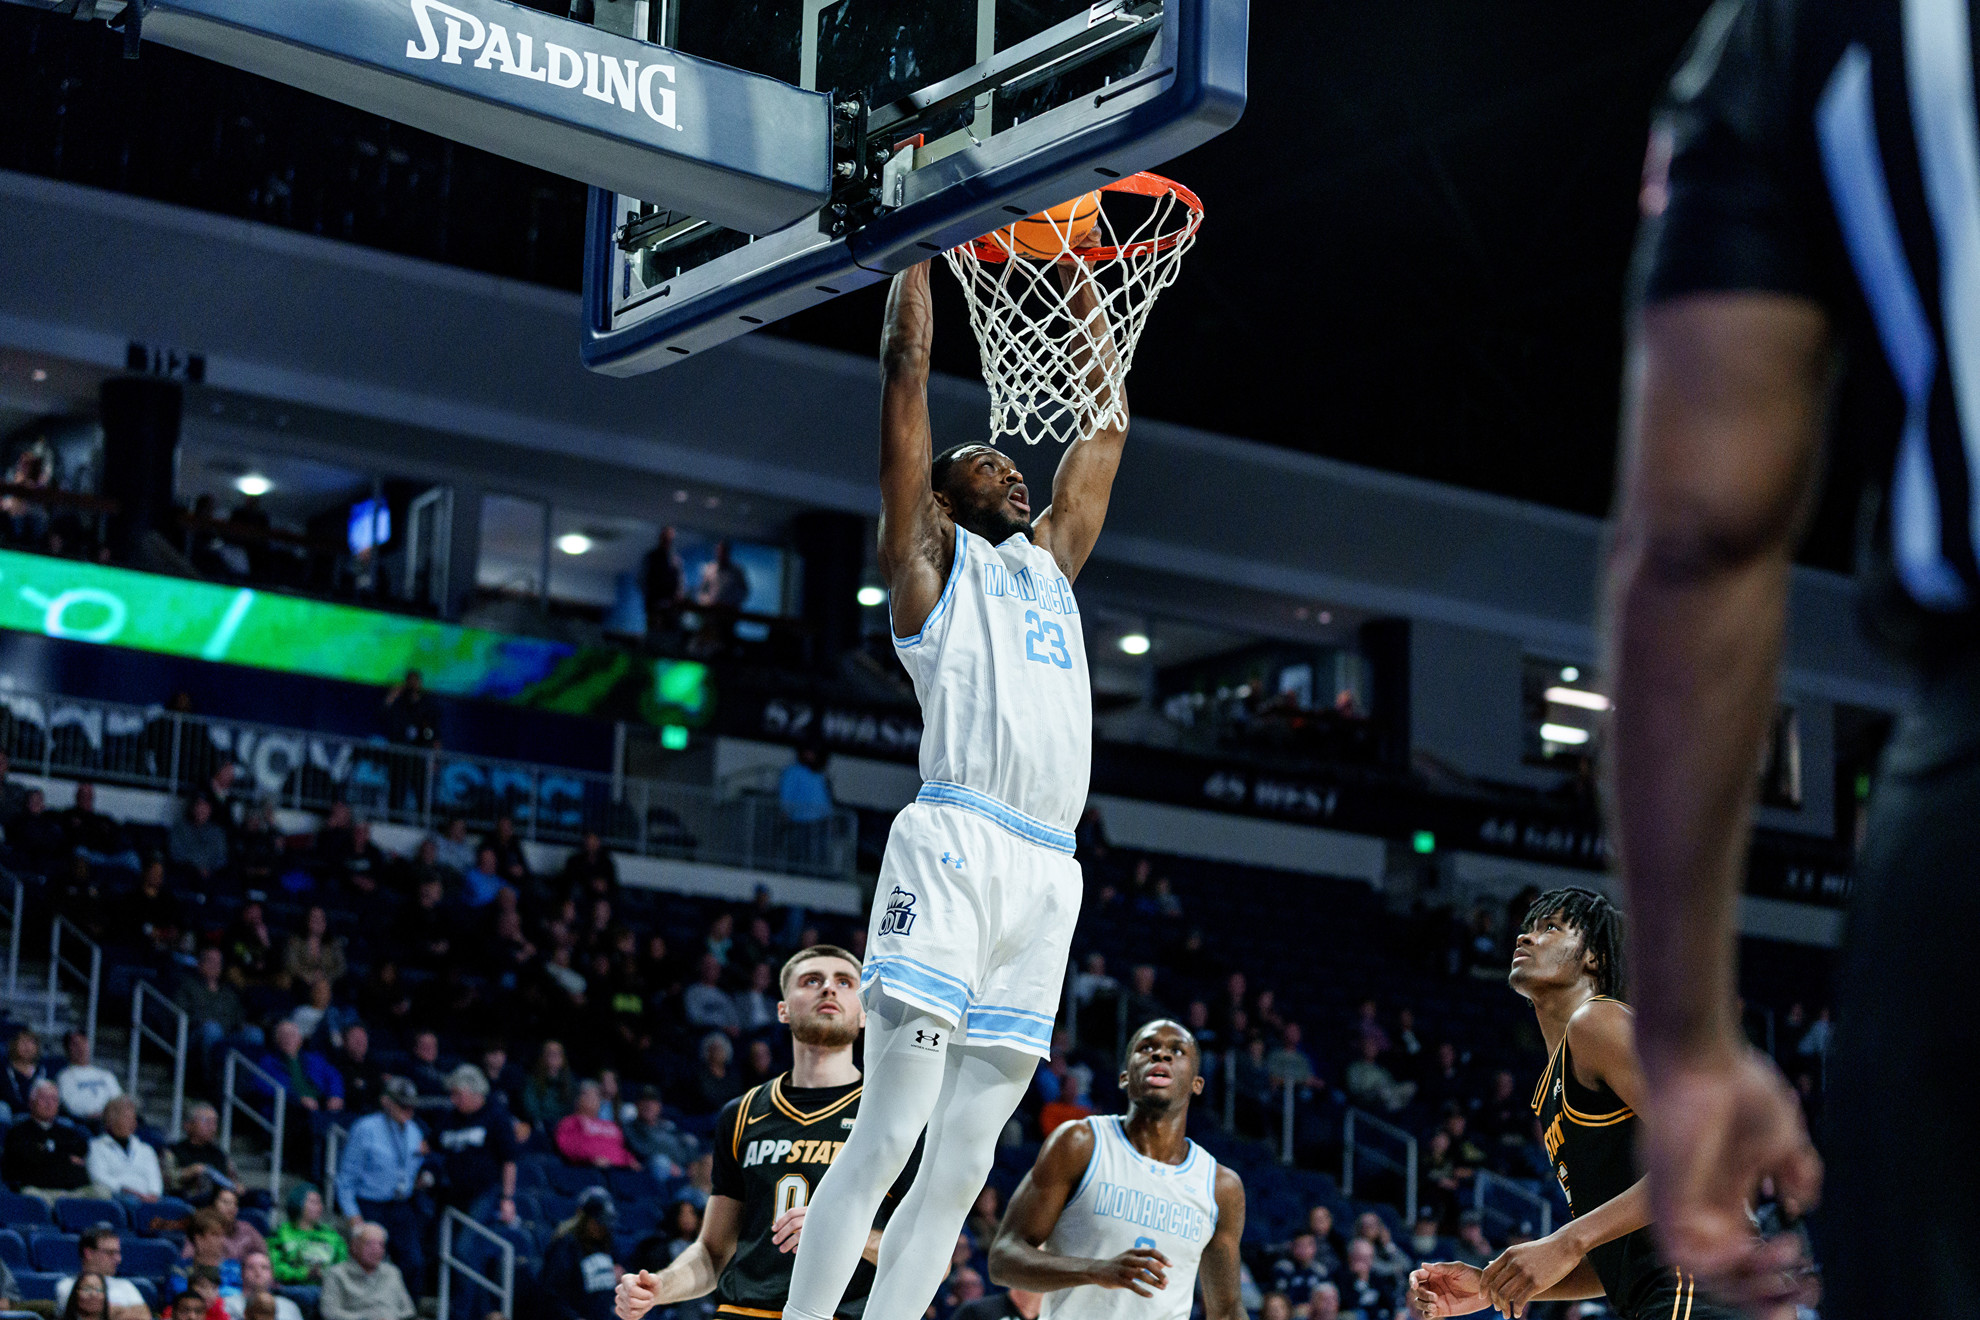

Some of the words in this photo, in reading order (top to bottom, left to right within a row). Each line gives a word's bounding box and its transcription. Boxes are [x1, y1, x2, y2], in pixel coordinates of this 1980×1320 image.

[405, 0, 677, 130] SPALDING
[983, 563, 1079, 615] MONRCH
[1024, 609, 1073, 669] 23
[1094, 1181, 1204, 1243] MONARCHS
